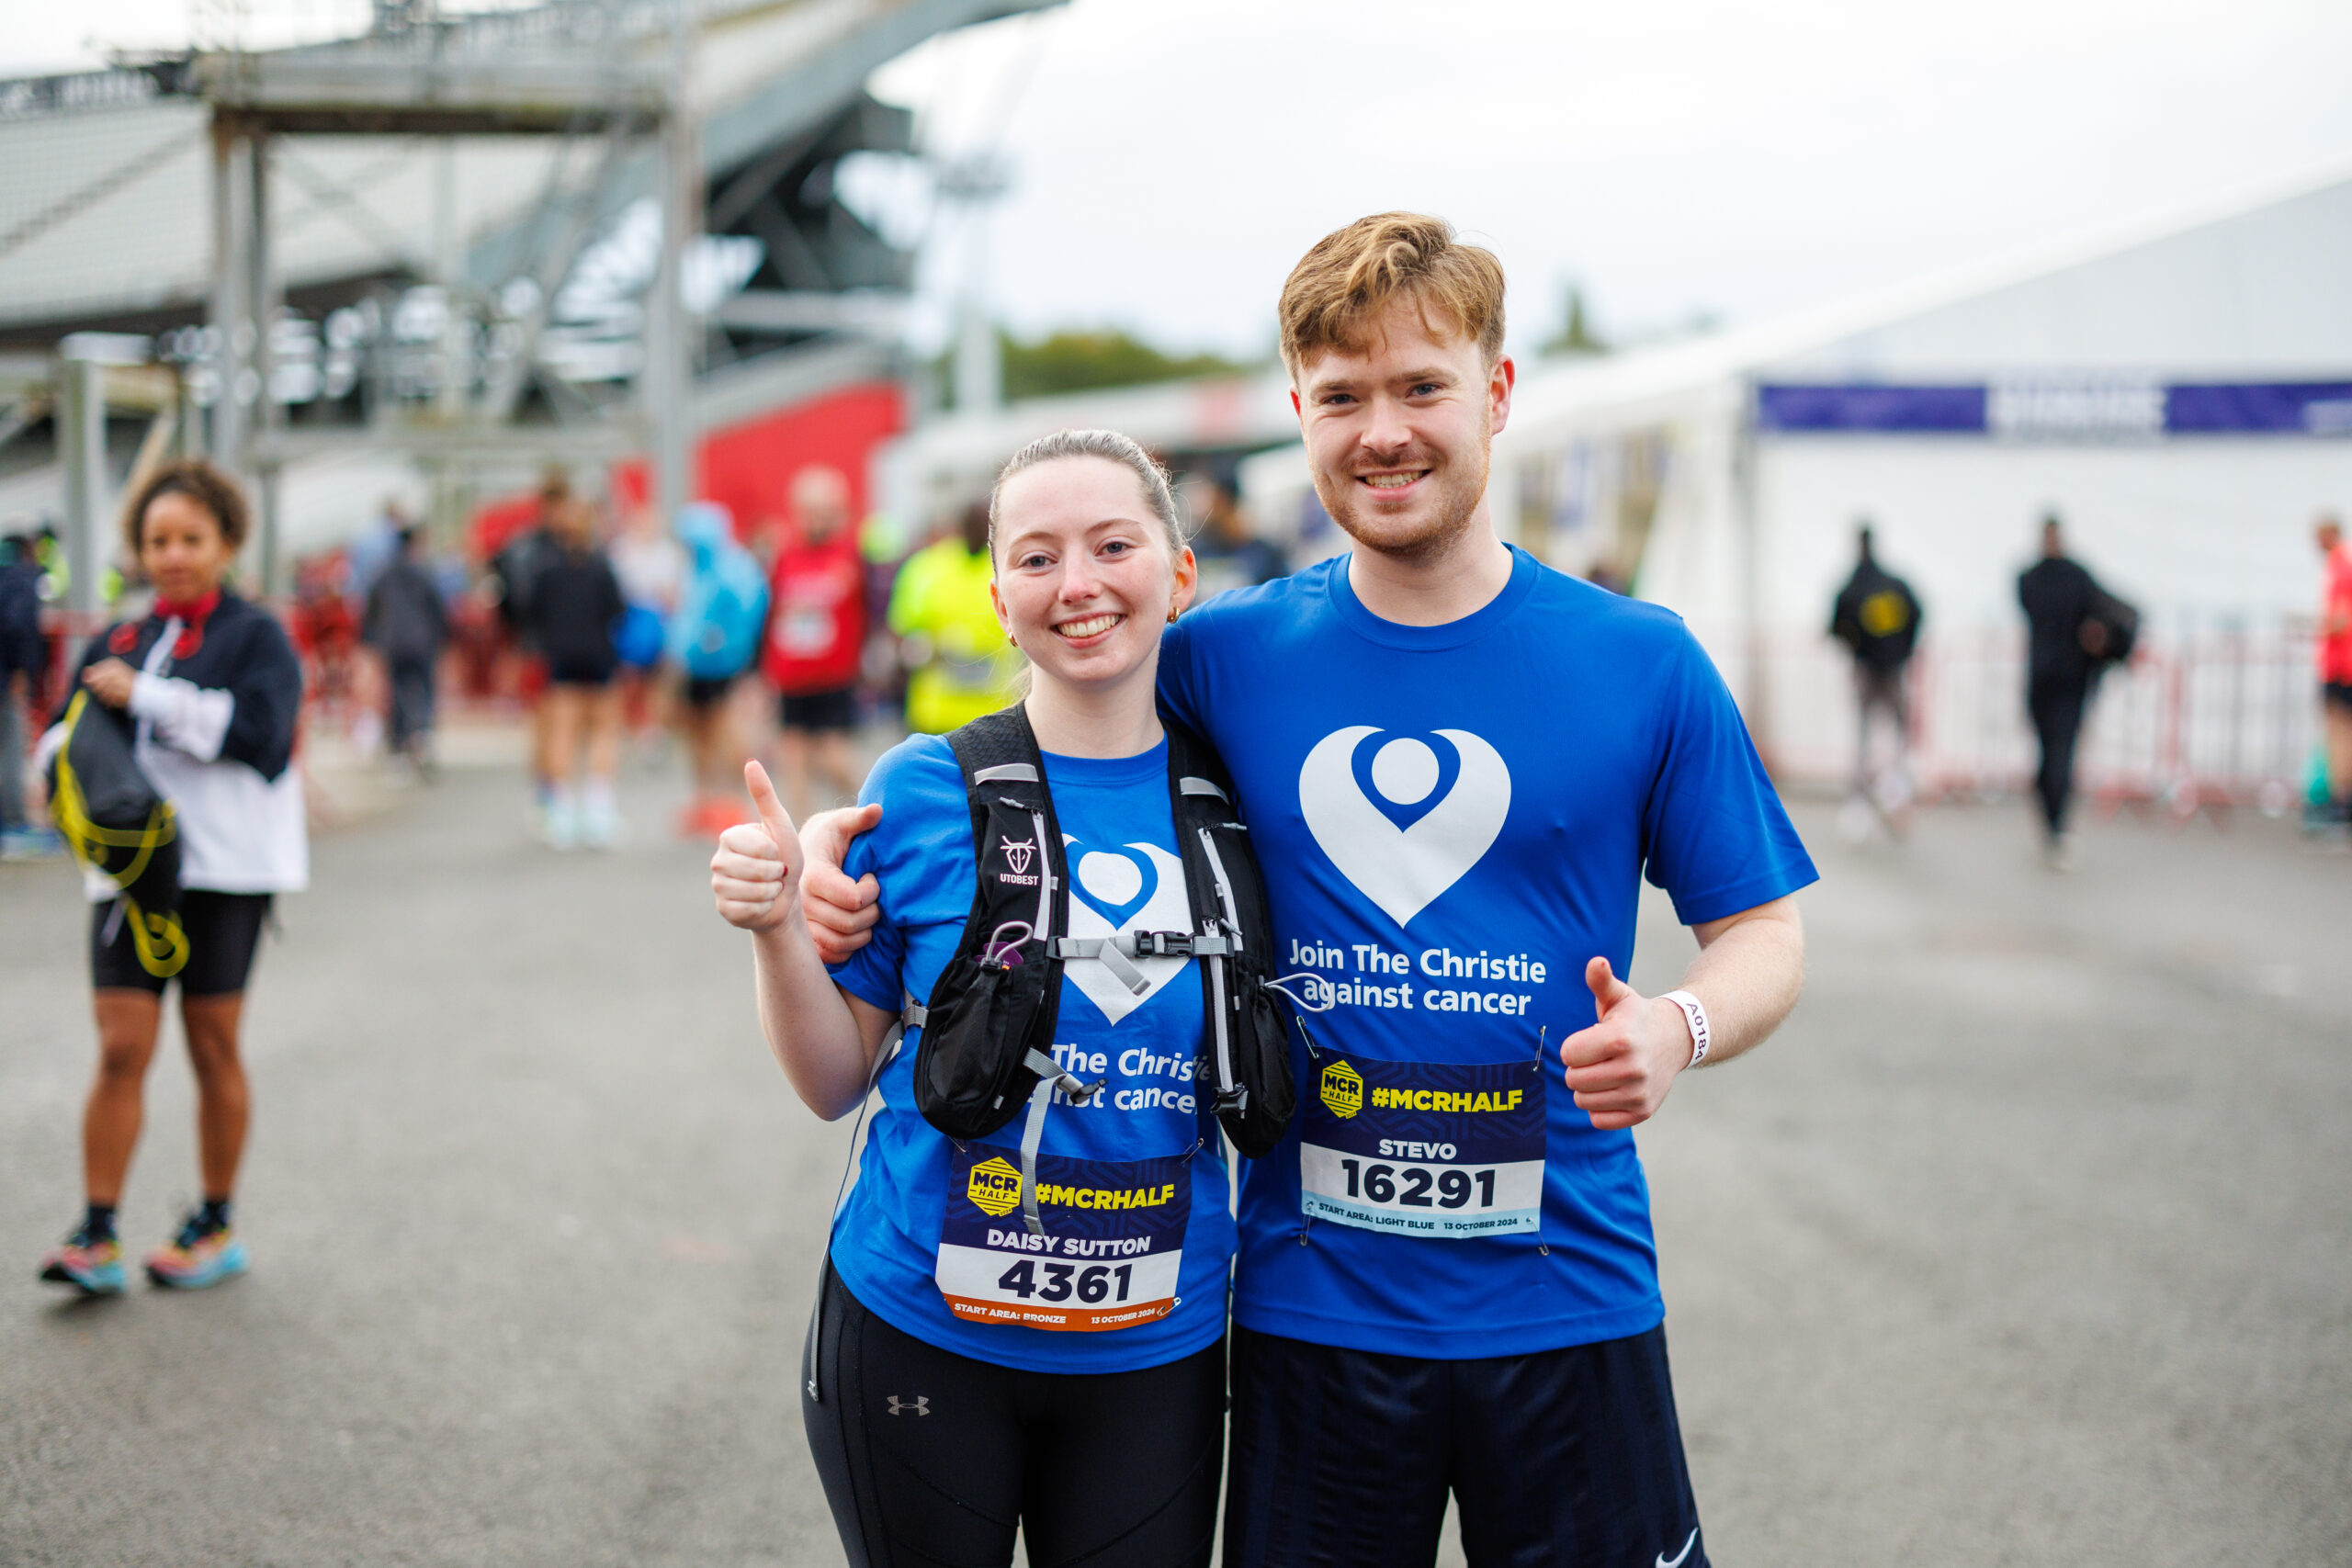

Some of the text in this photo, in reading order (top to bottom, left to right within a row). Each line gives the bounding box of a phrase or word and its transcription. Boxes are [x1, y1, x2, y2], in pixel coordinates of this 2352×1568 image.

[1000, 873, 1039, 886] UTOBEST
[1289, 938, 1547, 984] Join The Christie
[1304, 977, 1532, 1016] against cancer
[1051, 1043, 1108, 1074] The
[1324, 1073, 1360, 1096] MCR
[1329, 1090, 1353, 1102] HALF
[1114, 1087, 1198, 1116] cance
[1372, 1087, 1523, 1112] #MCRHALF
[1378, 1138, 1457, 1160] STEVO
[973, 1170, 1018, 1192] MCR
[1340, 1158, 1496, 1209] 16291
[978, 1189, 1010, 1200] HALF
[1035, 1183, 1175, 1211] #MCRHALF
[1318, 1202, 1435, 1230] START AREA: LIGHT BLUE
[1455, 1220, 1496, 1231] OCTOBER
[1497, 1218, 1518, 1227] 2024
[987, 1228, 1151, 1257] DAISY SUTTON
[998, 1259, 1133, 1304] 4361
[955, 1303, 1067, 1324] START AREA: BRONZE
[1091, 1308, 1156, 1325] 13 OCTOBER 2024
